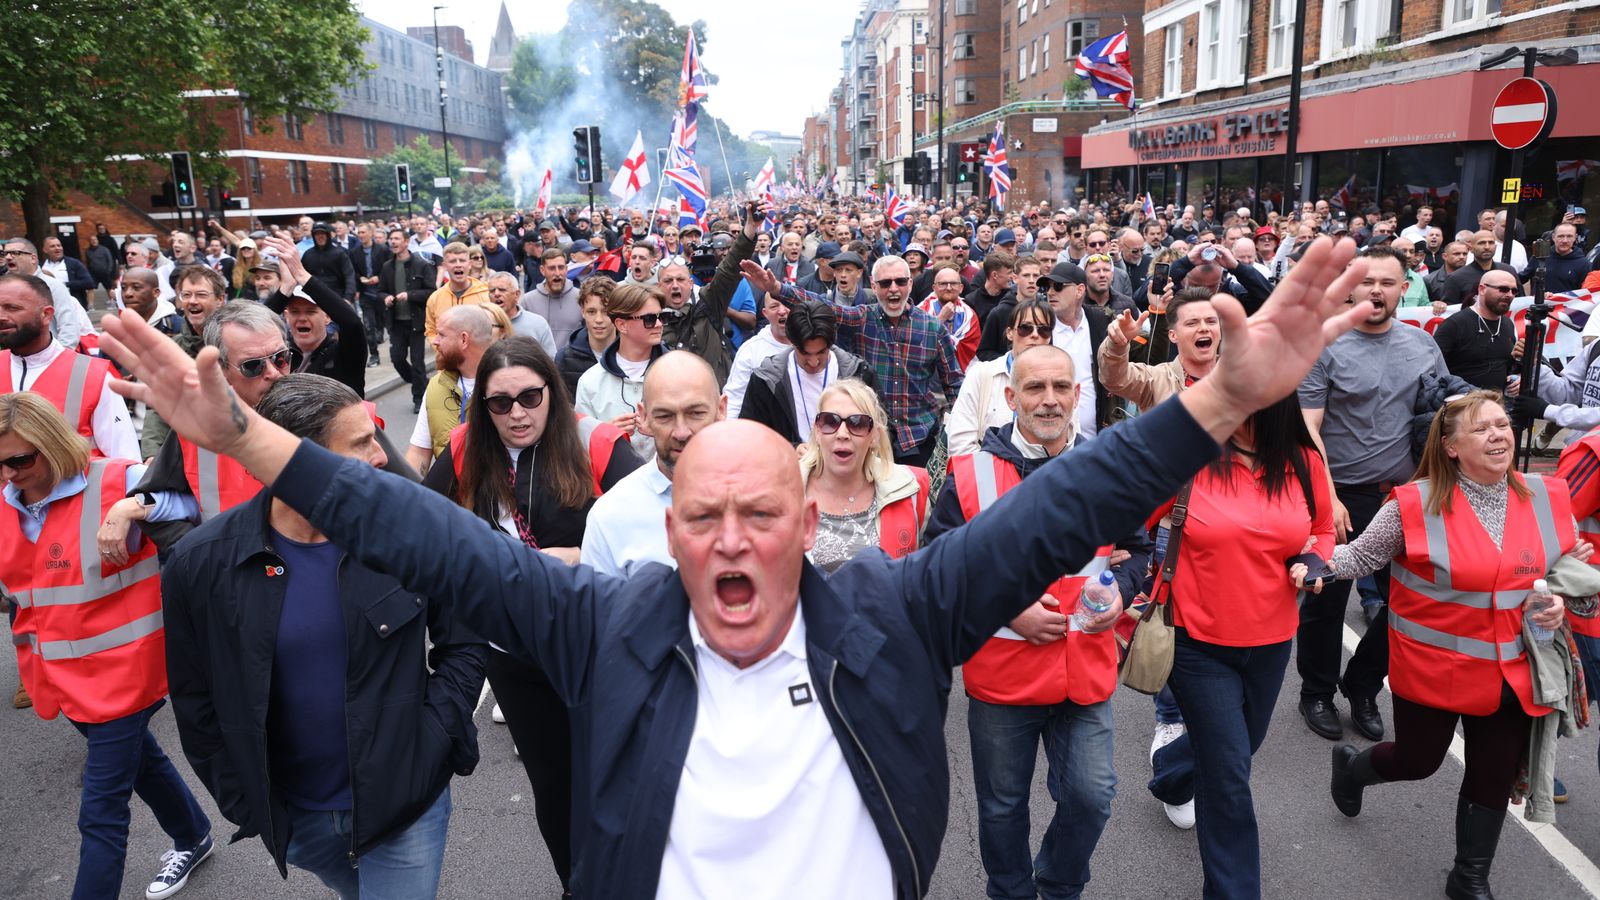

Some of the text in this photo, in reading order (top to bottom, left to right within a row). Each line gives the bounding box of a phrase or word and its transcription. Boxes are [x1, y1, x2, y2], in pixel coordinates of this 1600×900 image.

[1223, 109, 1289, 138] SPICE
[1141, 138, 1275, 161] CONTEMPORARY INDIAN CUISINE
[1503, 180, 1518, 201] H
